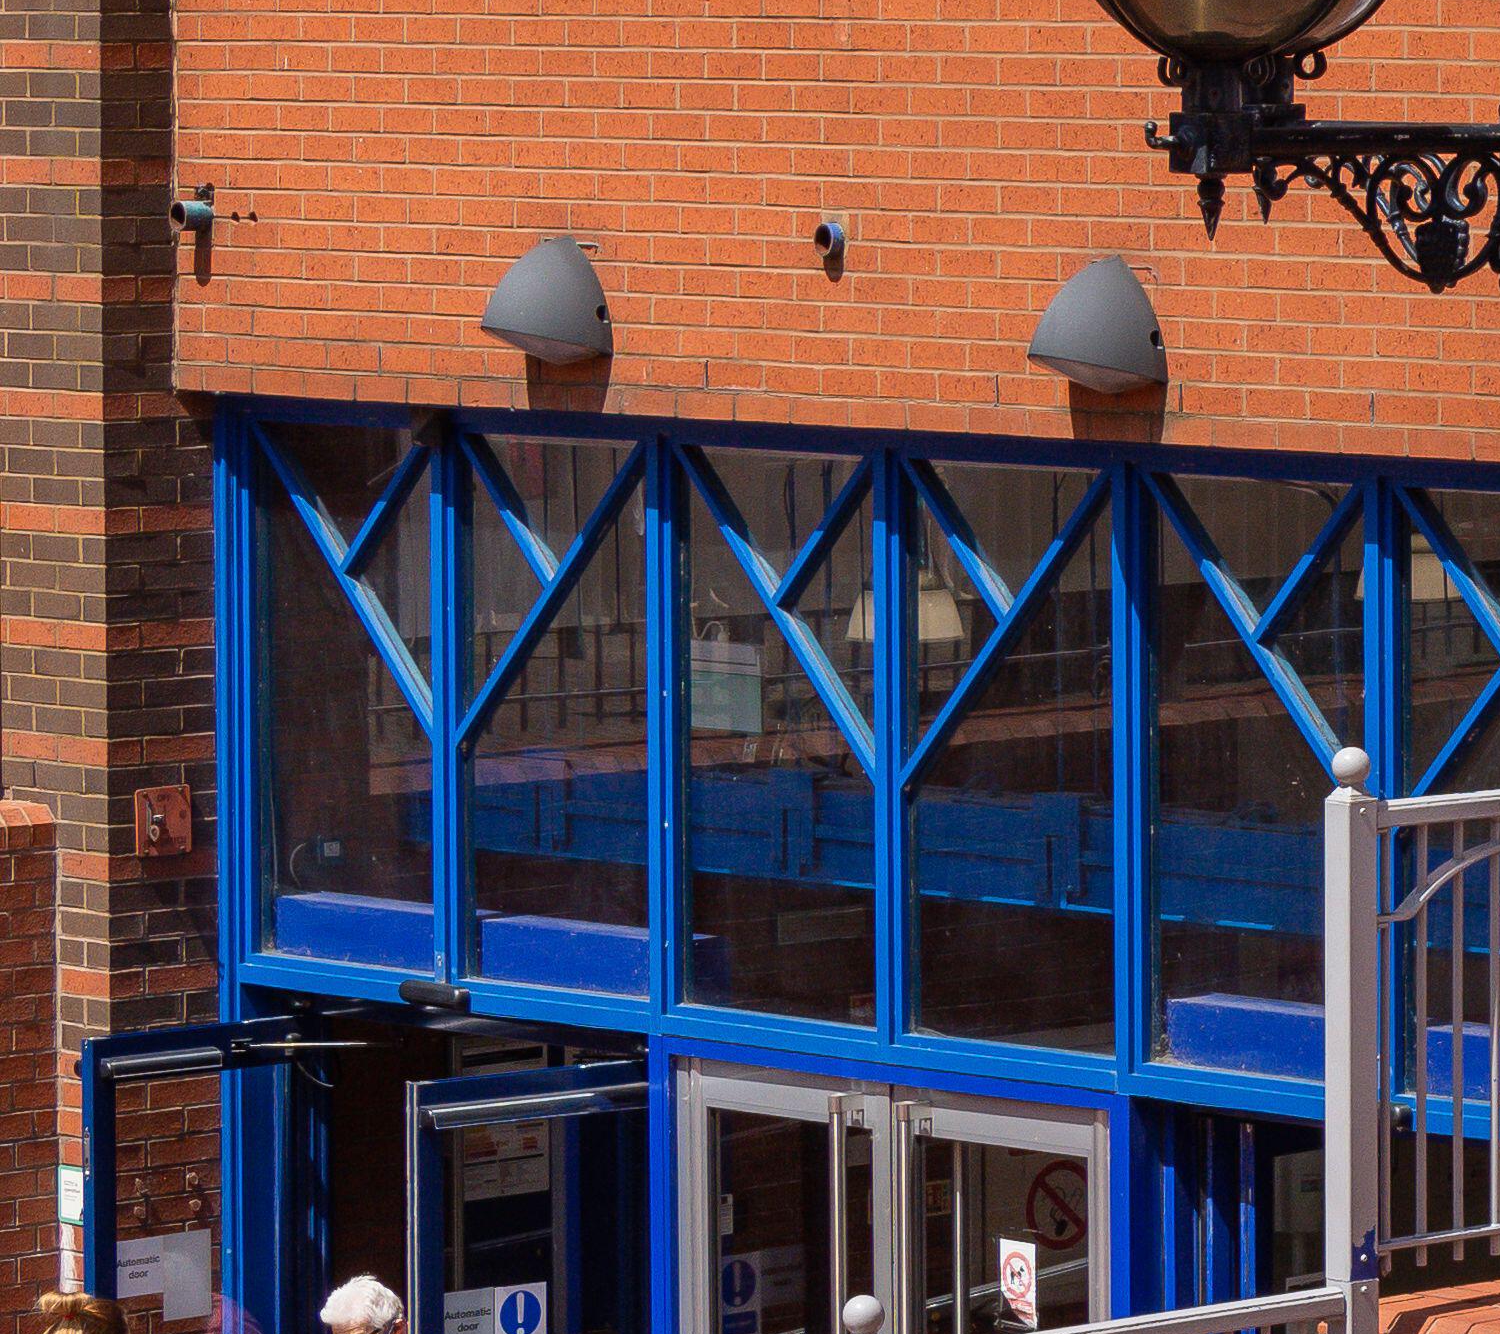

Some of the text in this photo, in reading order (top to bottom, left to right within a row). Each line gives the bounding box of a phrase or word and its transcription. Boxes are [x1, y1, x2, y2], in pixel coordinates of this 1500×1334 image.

[117, 1255, 160, 1268] Automatic
[128, 1270, 149, 1279] door
[444, 1307, 492, 1321] Automatic
[457, 1323, 479, 1333] door
